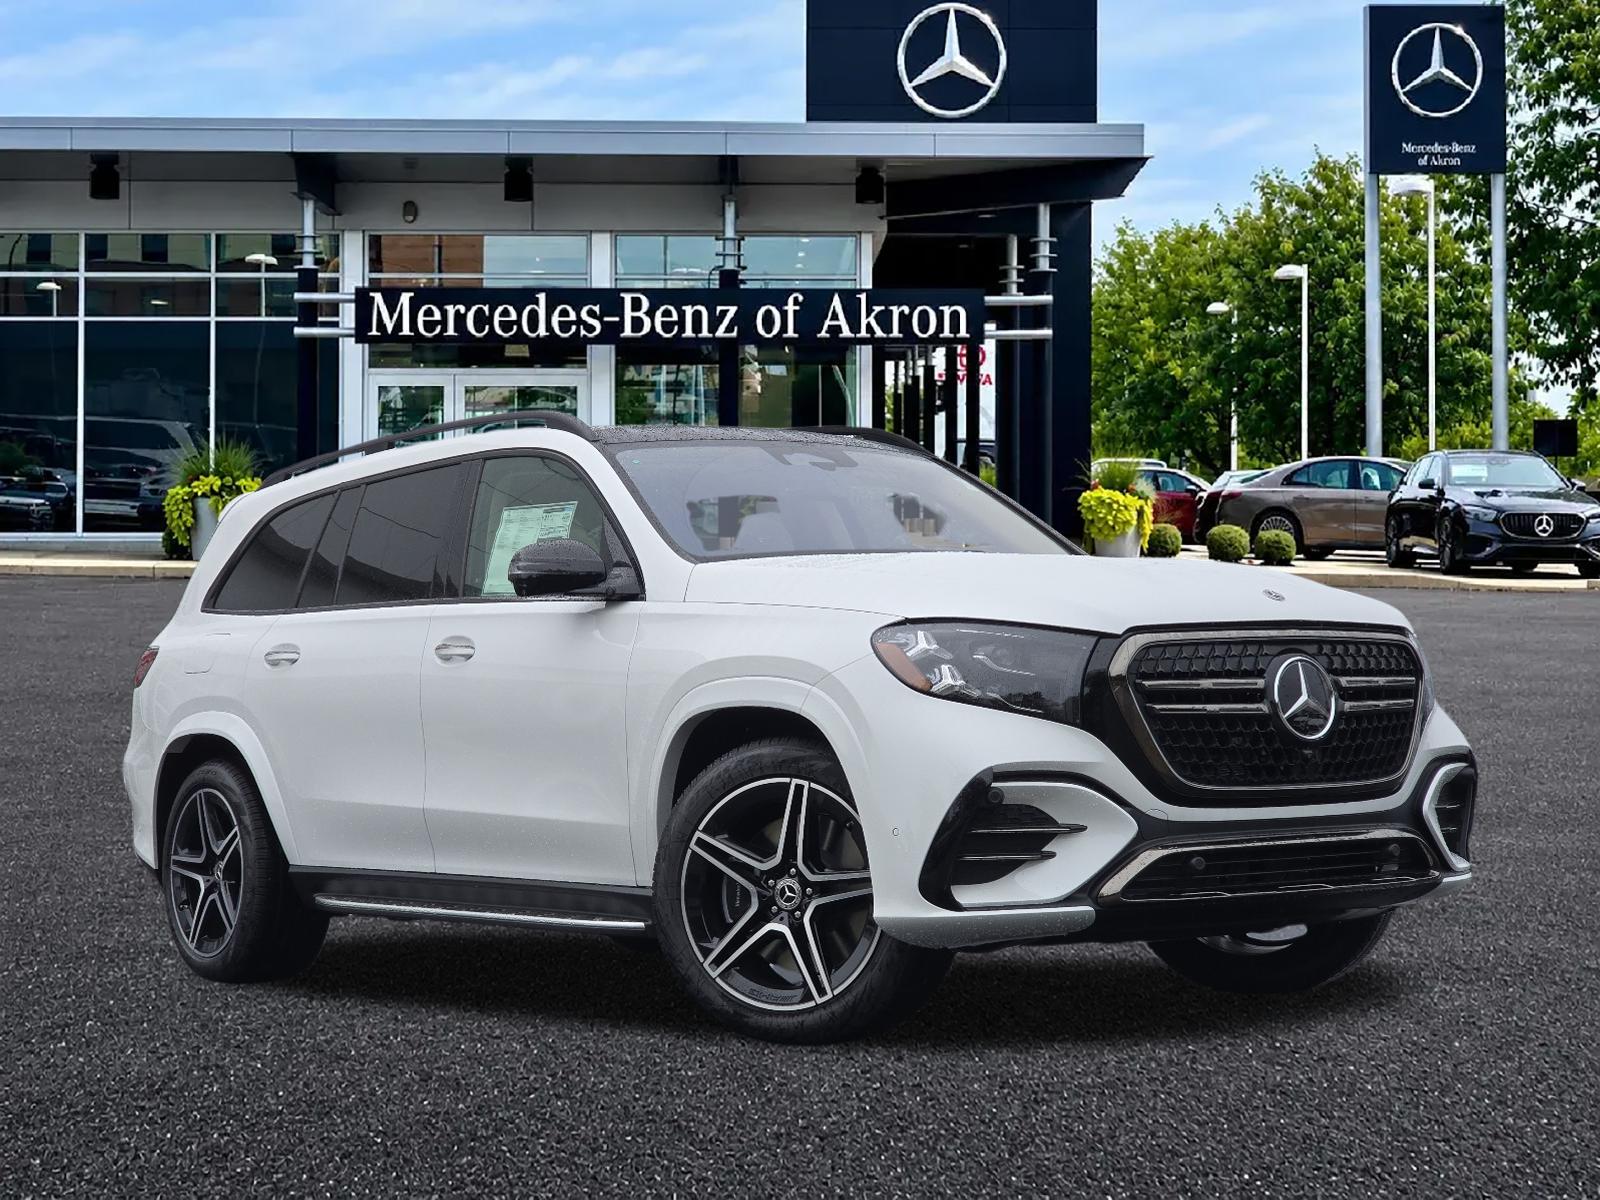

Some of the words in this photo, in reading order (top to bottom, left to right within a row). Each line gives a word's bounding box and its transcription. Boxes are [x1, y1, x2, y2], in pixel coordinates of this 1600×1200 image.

[1401, 142, 1477, 154] Mercedes-Benz
[1418, 155, 1429, 166] of
[1430, 155, 1461, 166] Akron
[367, 292, 738, 338] Mercedes-Benz
[755, 292, 804, 338] of
[816, 292, 970, 338] Akron
